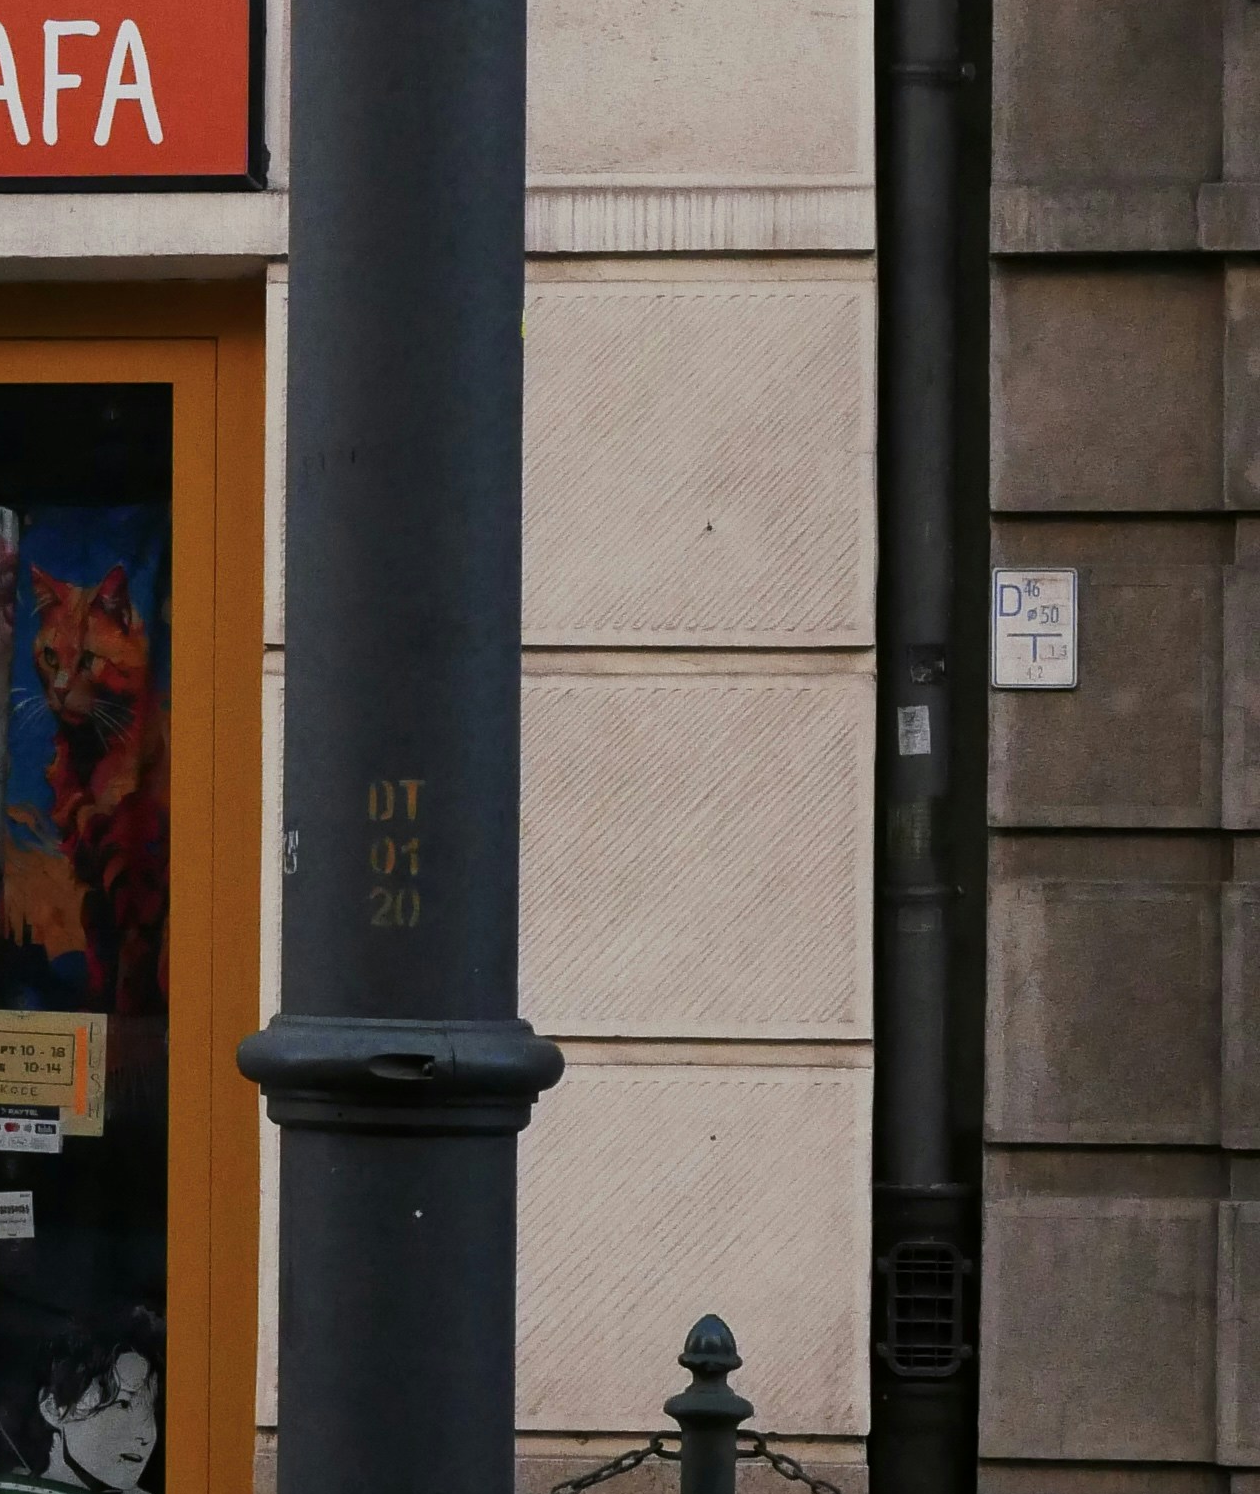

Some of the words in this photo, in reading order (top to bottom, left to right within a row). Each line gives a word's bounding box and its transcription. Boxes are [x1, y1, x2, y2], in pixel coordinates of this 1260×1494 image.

[999, 584, 1022, 617] D
[368, 779, 426, 821] DT
[370, 836, 421, 875] 01
[369, 885, 421, 927] 20
[20, 1045, 35, 1056] 10
[50, 1046, 66, 1058] 18
